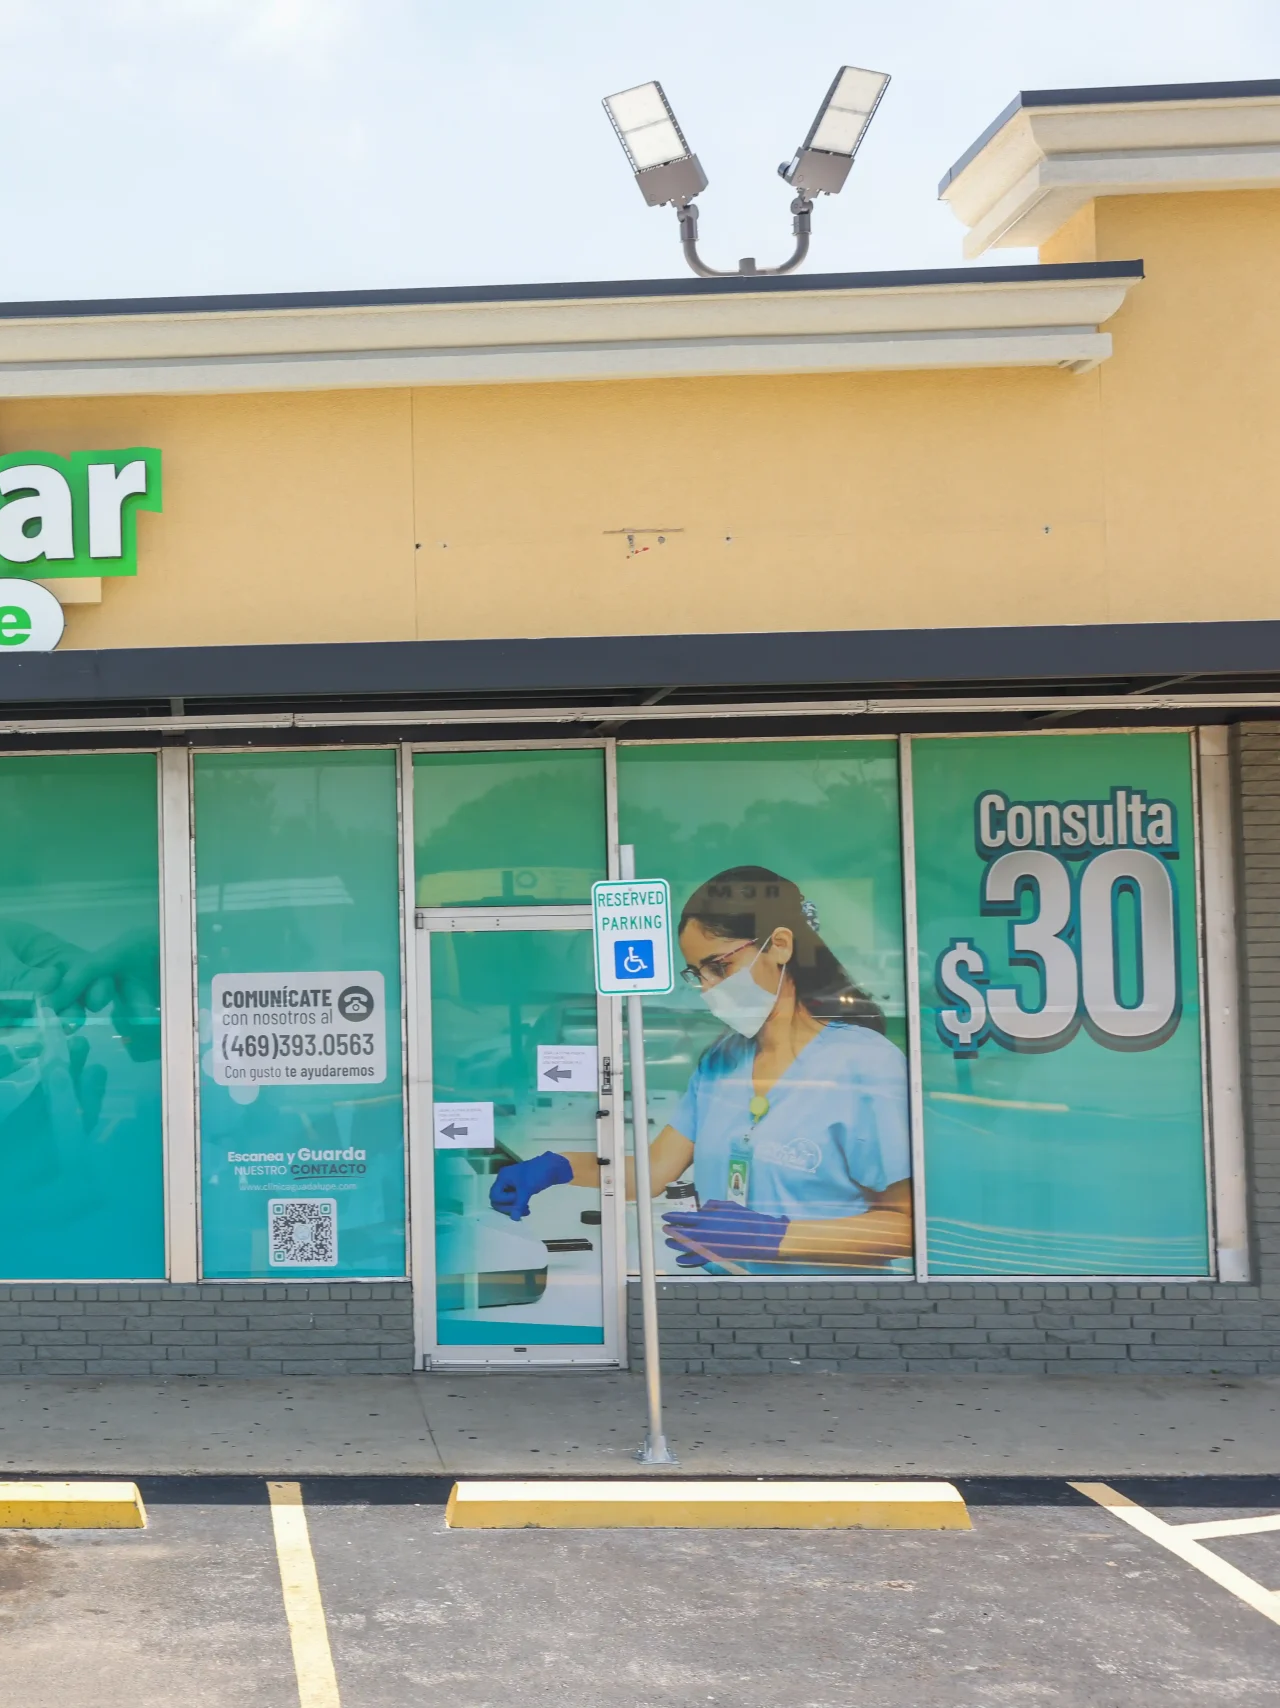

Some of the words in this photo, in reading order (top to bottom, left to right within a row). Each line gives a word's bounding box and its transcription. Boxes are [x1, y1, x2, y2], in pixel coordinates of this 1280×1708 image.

[980, 790, 1173, 848] Consulta
[598, 891, 664, 907] RESERVED
[602, 915, 662, 931] PARKING
[940, 848, 1176, 1044] $30
[222, 986, 333, 1009] COMUNÍCATE
[222, 1013, 248, 1026] con
[253, 1011, 316, 1025] nosotros
[321, 1009, 333, 1024] al
[222, 1033, 375, 1060] (469)393.0563
[225, 1066, 246, 1079] Con
[250, 1066, 282, 1082] gusto
[285, 1065, 297, 1078] te
[300, 1064, 375, 1081] ayudaremos
[227, 1151, 284, 1162] Escanea
[287, 1152, 296, 1164] y
[298, 1147, 366, 1161] Guarda
[234, 1166, 287, 1176] NUESTRO
[290, 1164, 366, 1175] CONTACTO
[239, 1182, 357, 1192] www.clinicaguadalupe.com
